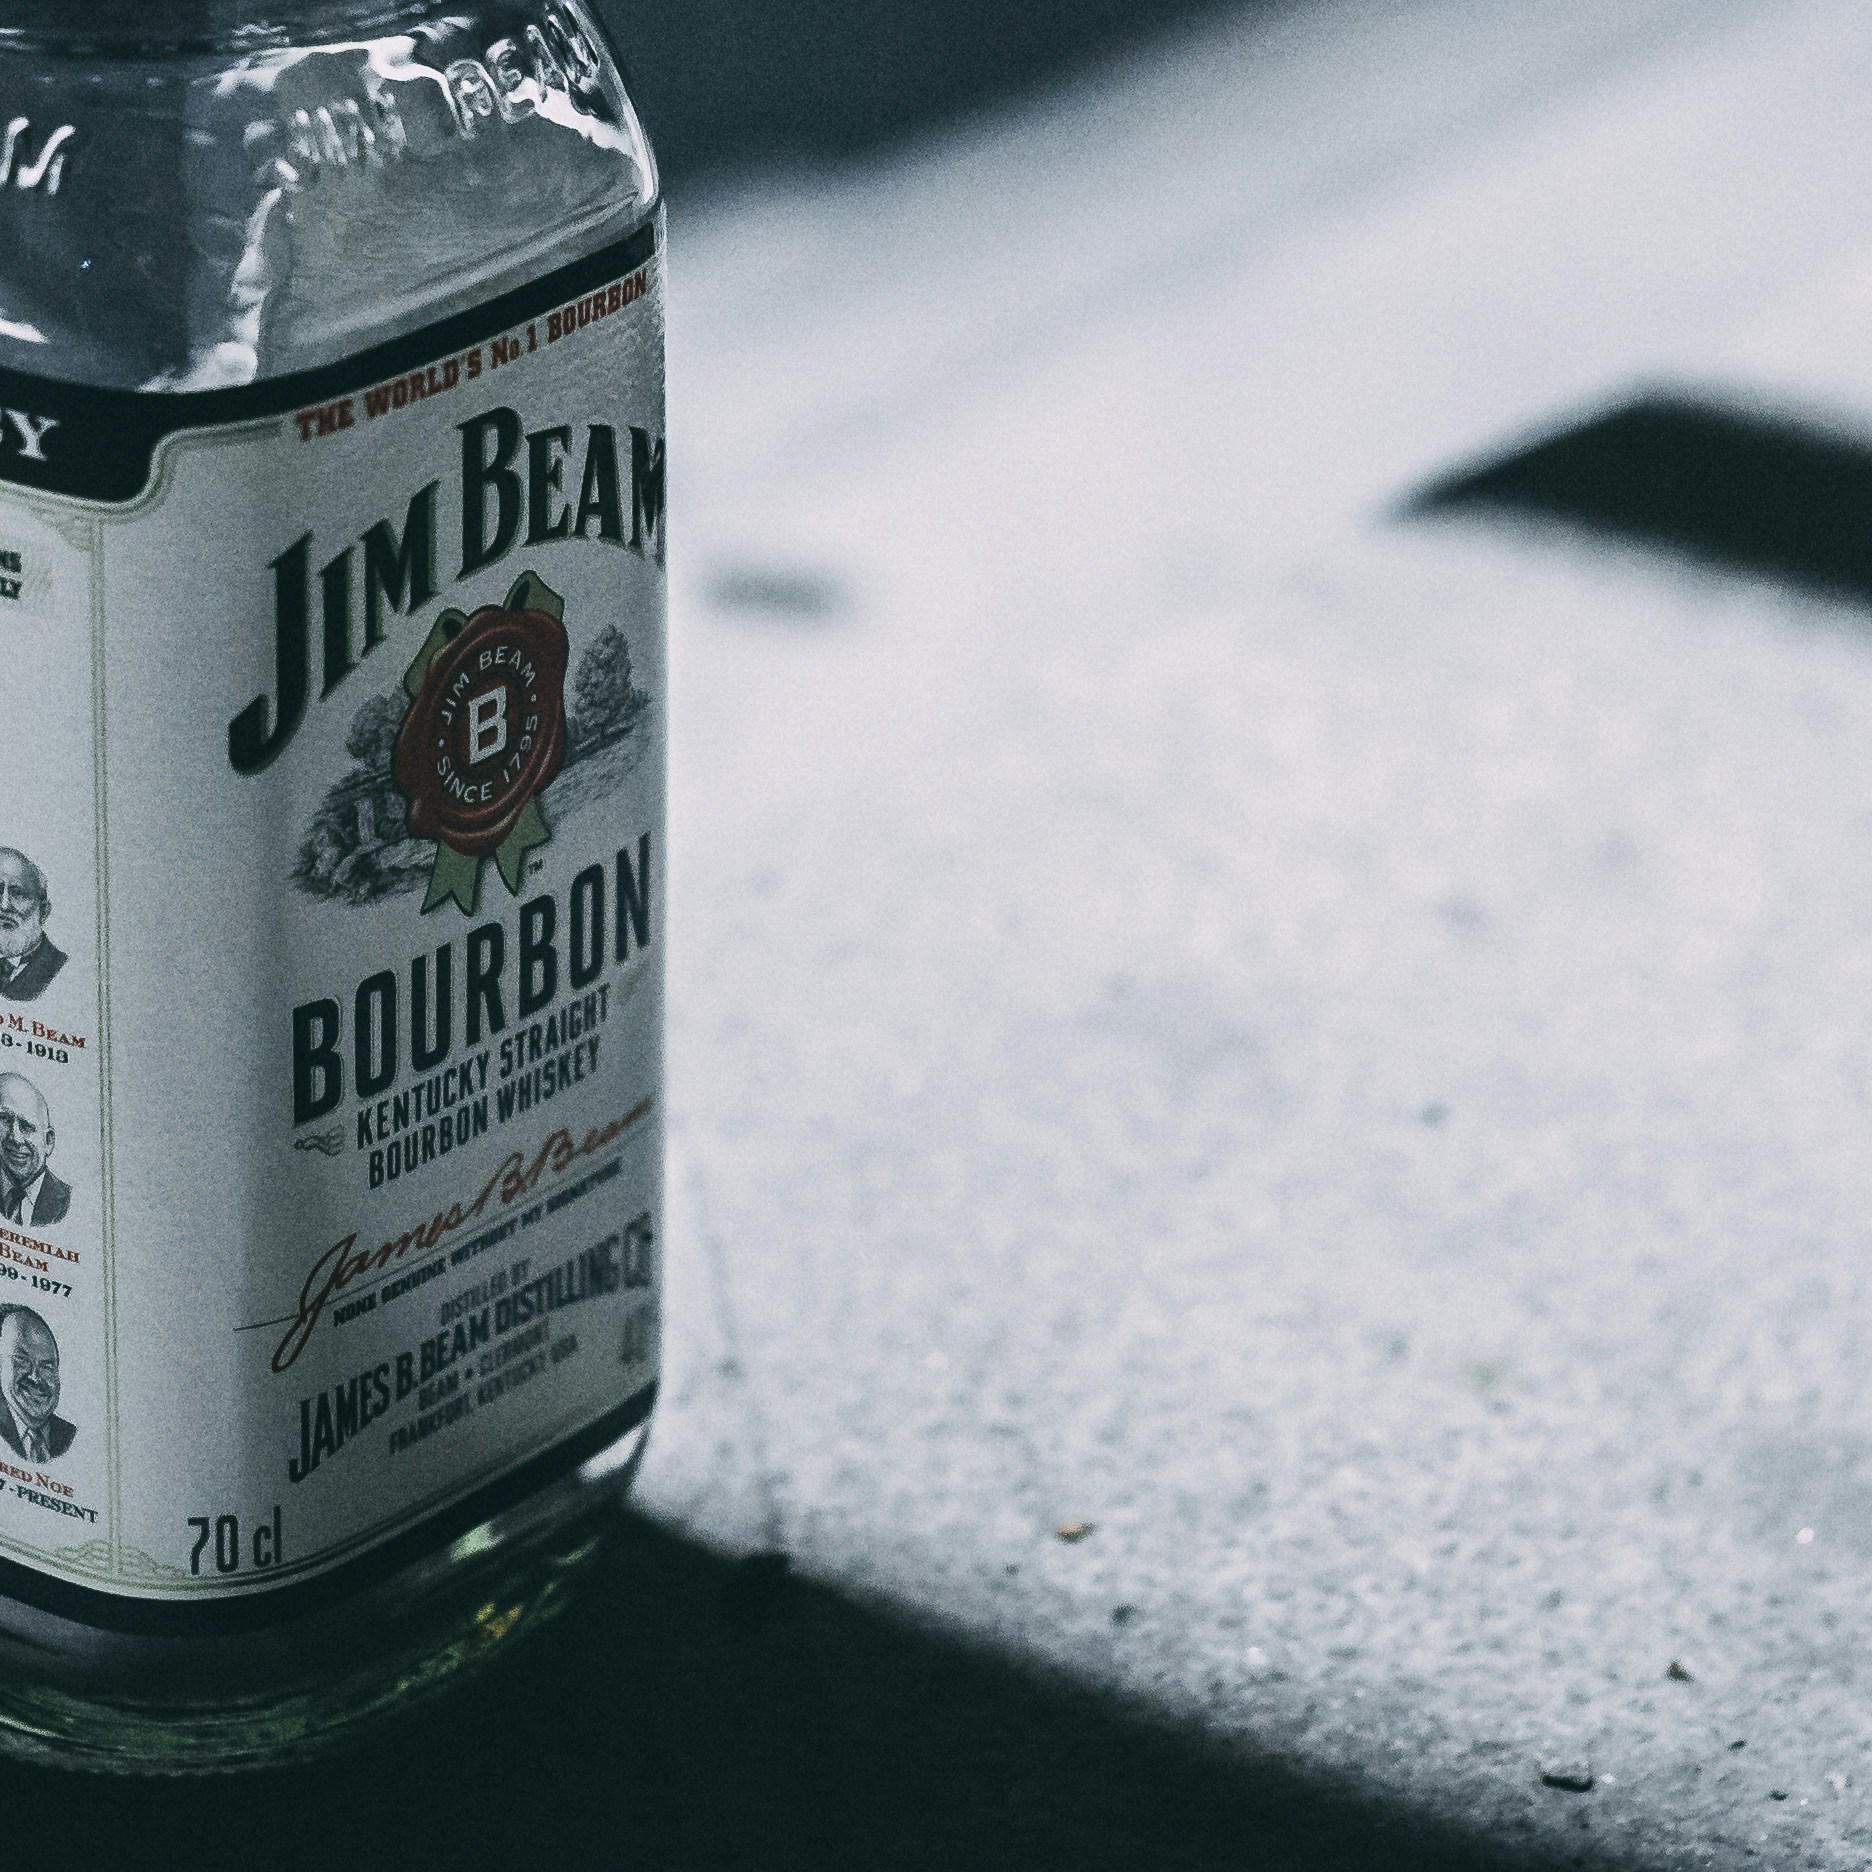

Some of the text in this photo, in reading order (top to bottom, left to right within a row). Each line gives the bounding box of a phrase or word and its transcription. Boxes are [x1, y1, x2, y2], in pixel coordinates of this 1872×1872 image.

[295, 398, 355, 443] THE
[363, 348, 483, 421] WORLD'S
[547, 268, 648, 344] BOURBON
[226, 405, 666, 778] JIM BEAM
[437, 714, 538, 803] SINCE 1795
[441, 645, 536, 726] JIM BEAM
[468, 685, 507, 765] B
[292, 831, 652, 1127] BOURBON
[357, 983, 611, 1150] KENTUCKY STRAIGHT
[369, 1094, 488, 1190] BOURBON
[496, 1034, 600, 1124] WHISKEY
[287, 1363, 390, 1484] JAMES
[420, 1307, 491, 1384] BEAM
[187, 1505, 282, 1575] 70 cl
